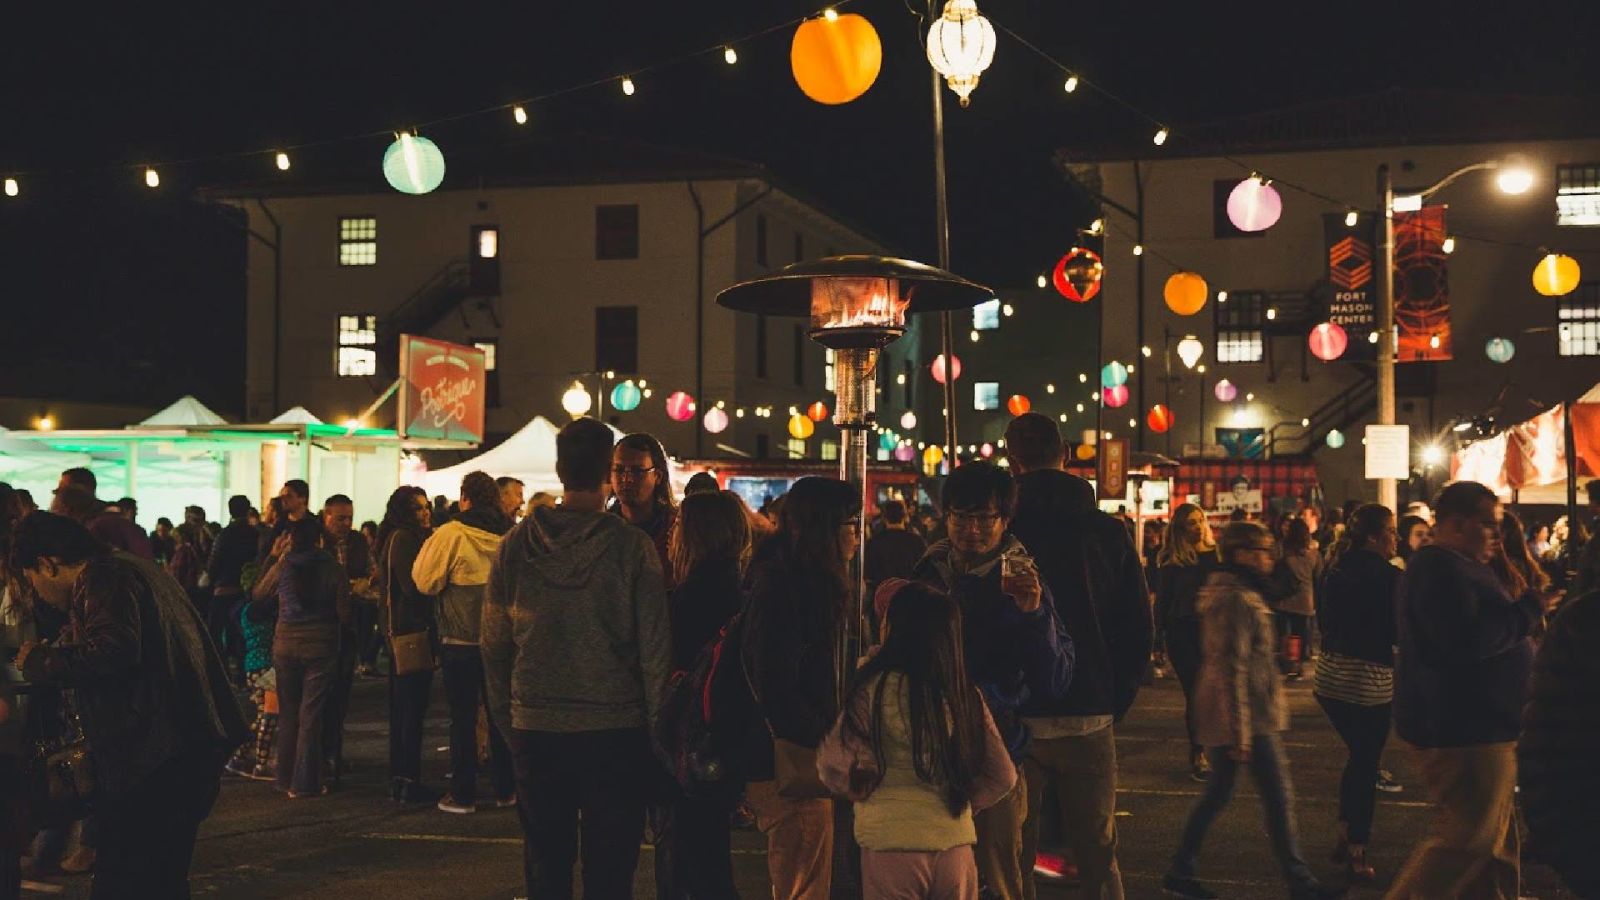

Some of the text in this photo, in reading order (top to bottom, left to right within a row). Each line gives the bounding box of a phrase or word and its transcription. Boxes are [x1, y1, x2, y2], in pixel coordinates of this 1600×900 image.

[1335, 292, 1366, 302] FORT
[1330, 304, 1373, 313] MASON
[1329, 315, 1373, 324] CENTER
